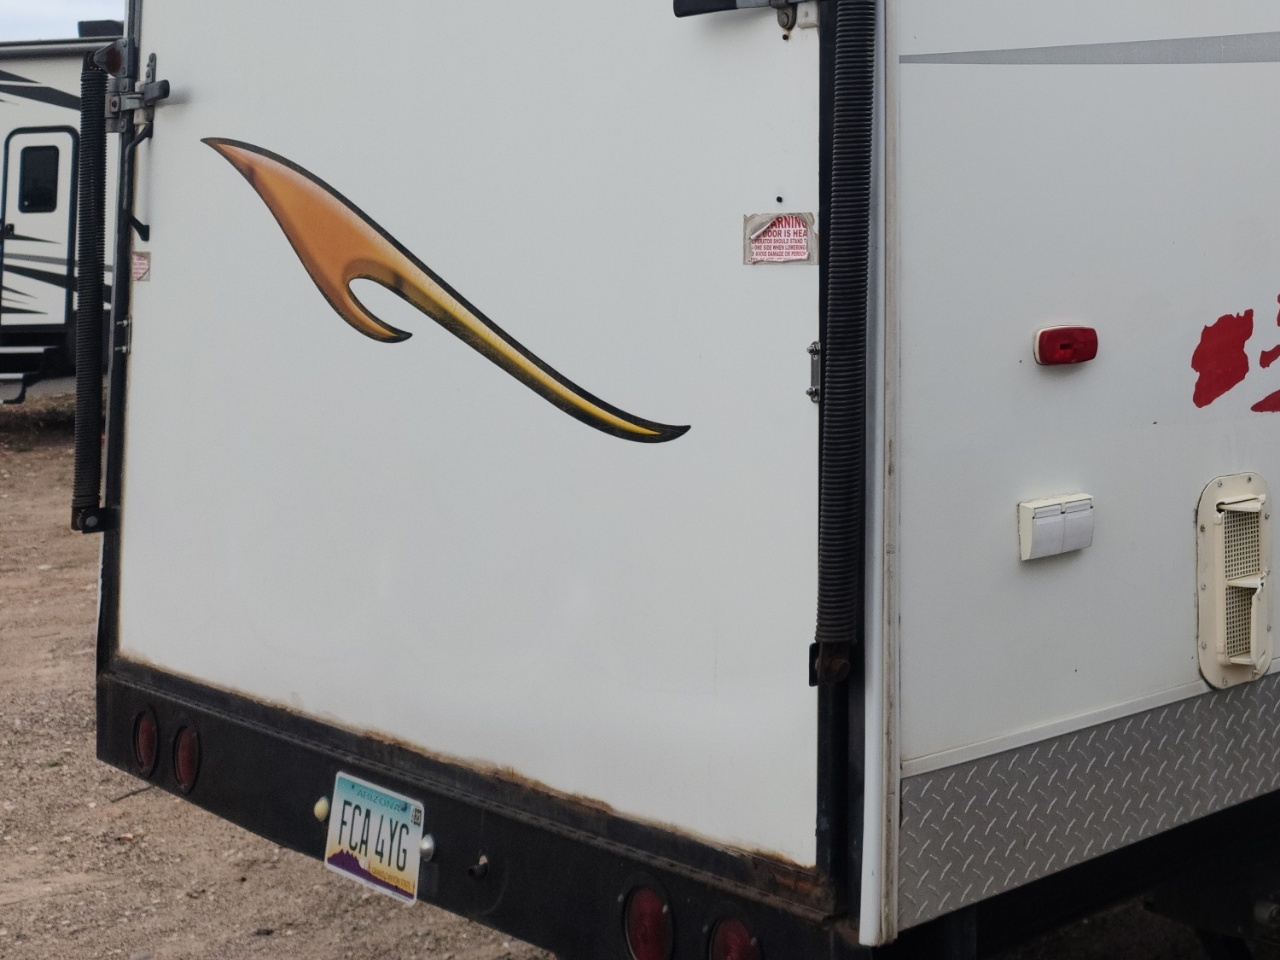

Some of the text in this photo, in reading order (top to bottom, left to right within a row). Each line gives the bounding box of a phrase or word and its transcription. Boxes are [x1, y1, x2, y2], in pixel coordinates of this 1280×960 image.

[763, 229, 782, 238] DOOR
[784, 229, 791, 238] IS
[356, 788, 400, 812] ARIZONA
[338, 800, 409, 872] FCA 4YG
